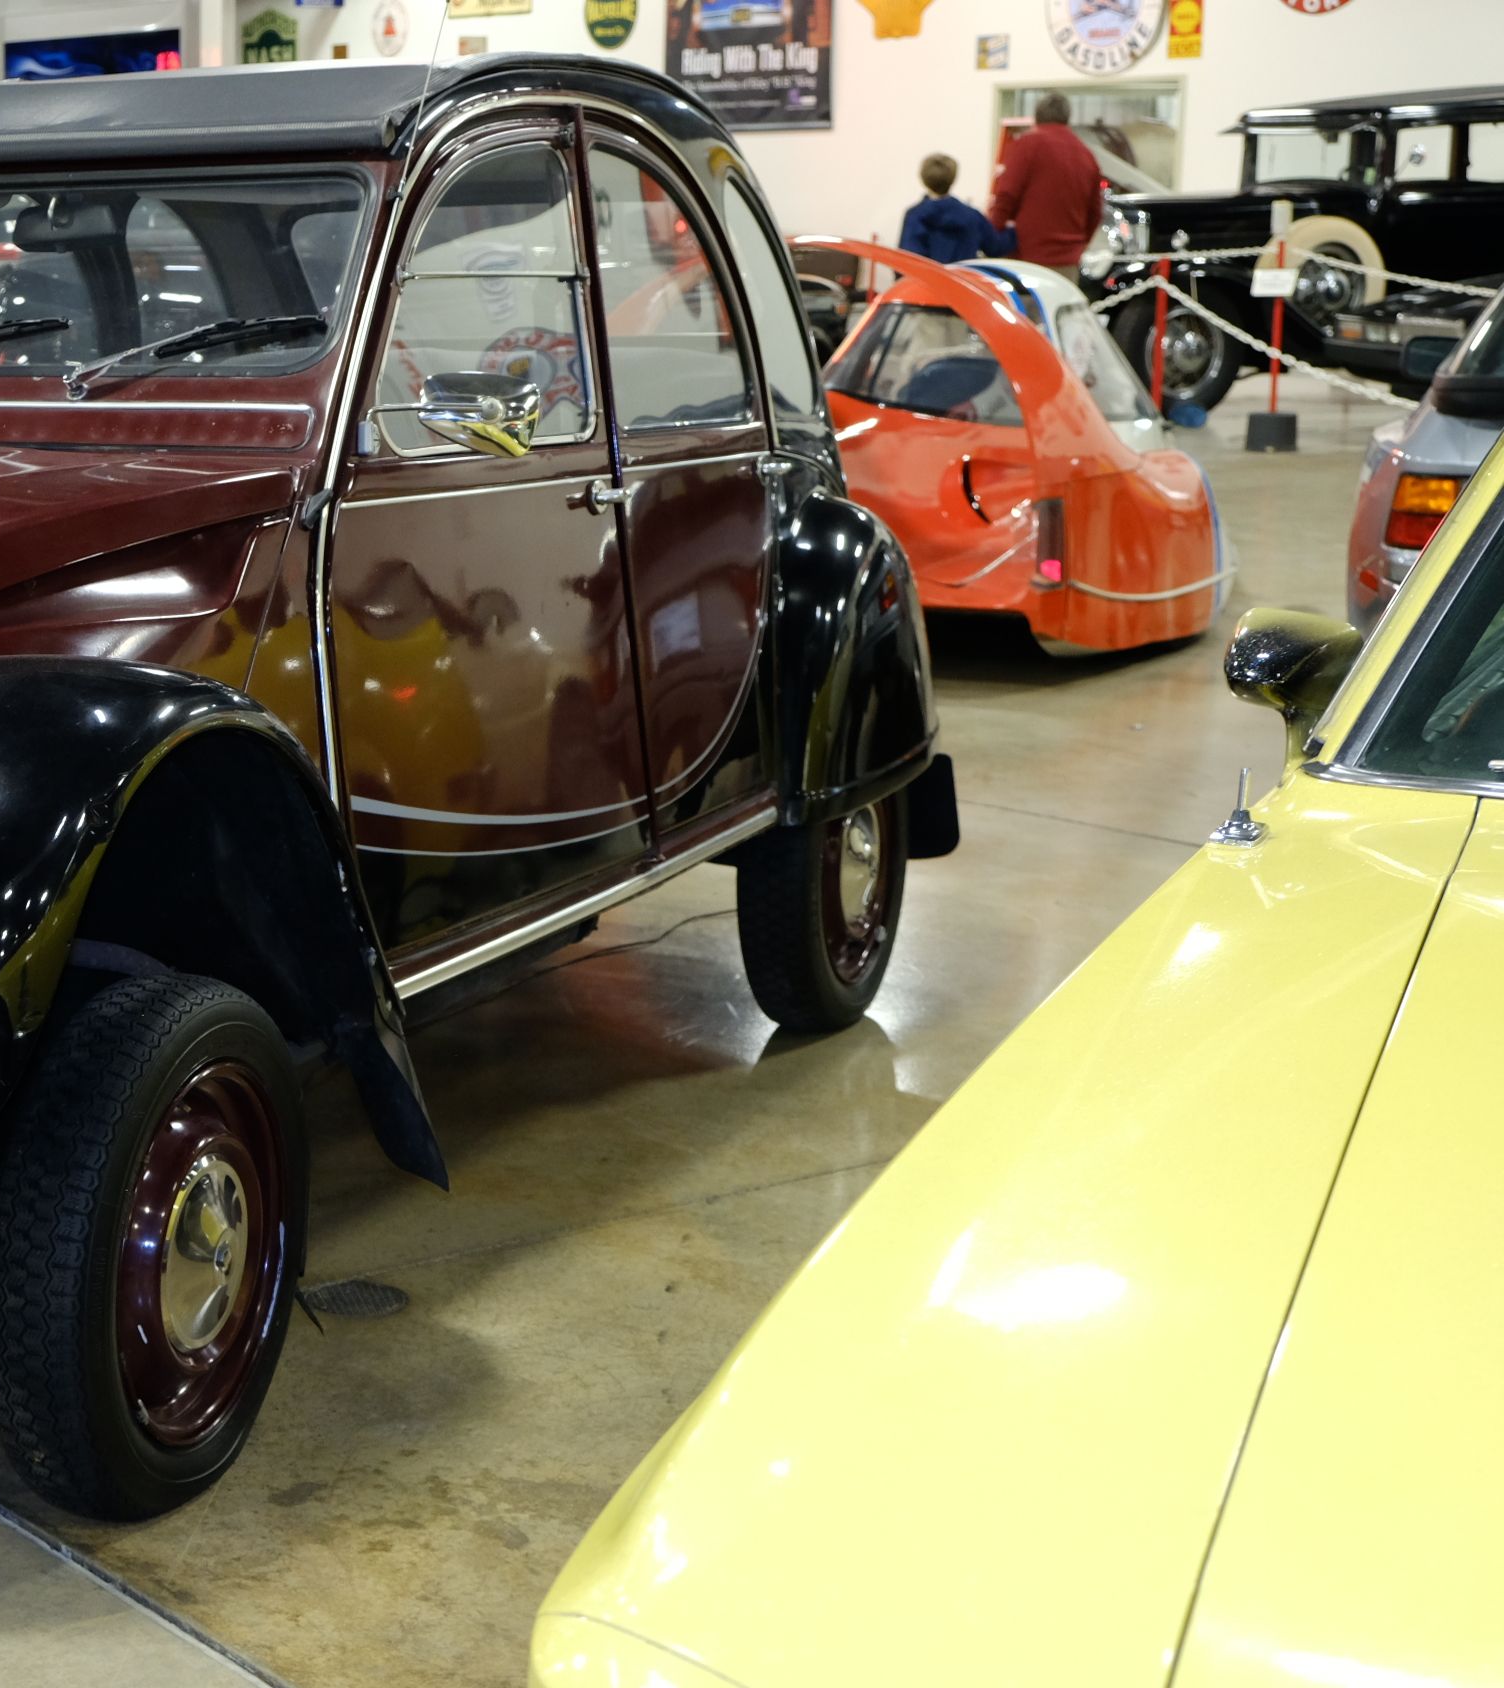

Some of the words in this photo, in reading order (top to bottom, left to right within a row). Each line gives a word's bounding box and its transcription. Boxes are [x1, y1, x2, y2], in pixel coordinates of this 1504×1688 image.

[244, 44, 295, 63] NASH
[681, 47, 722, 79] Riding
[723, 44, 756, 74] With
[757, 42, 785, 72] The
[785, 41, 819, 74] King
[1056, 22, 1151, 70] GASOLINE
